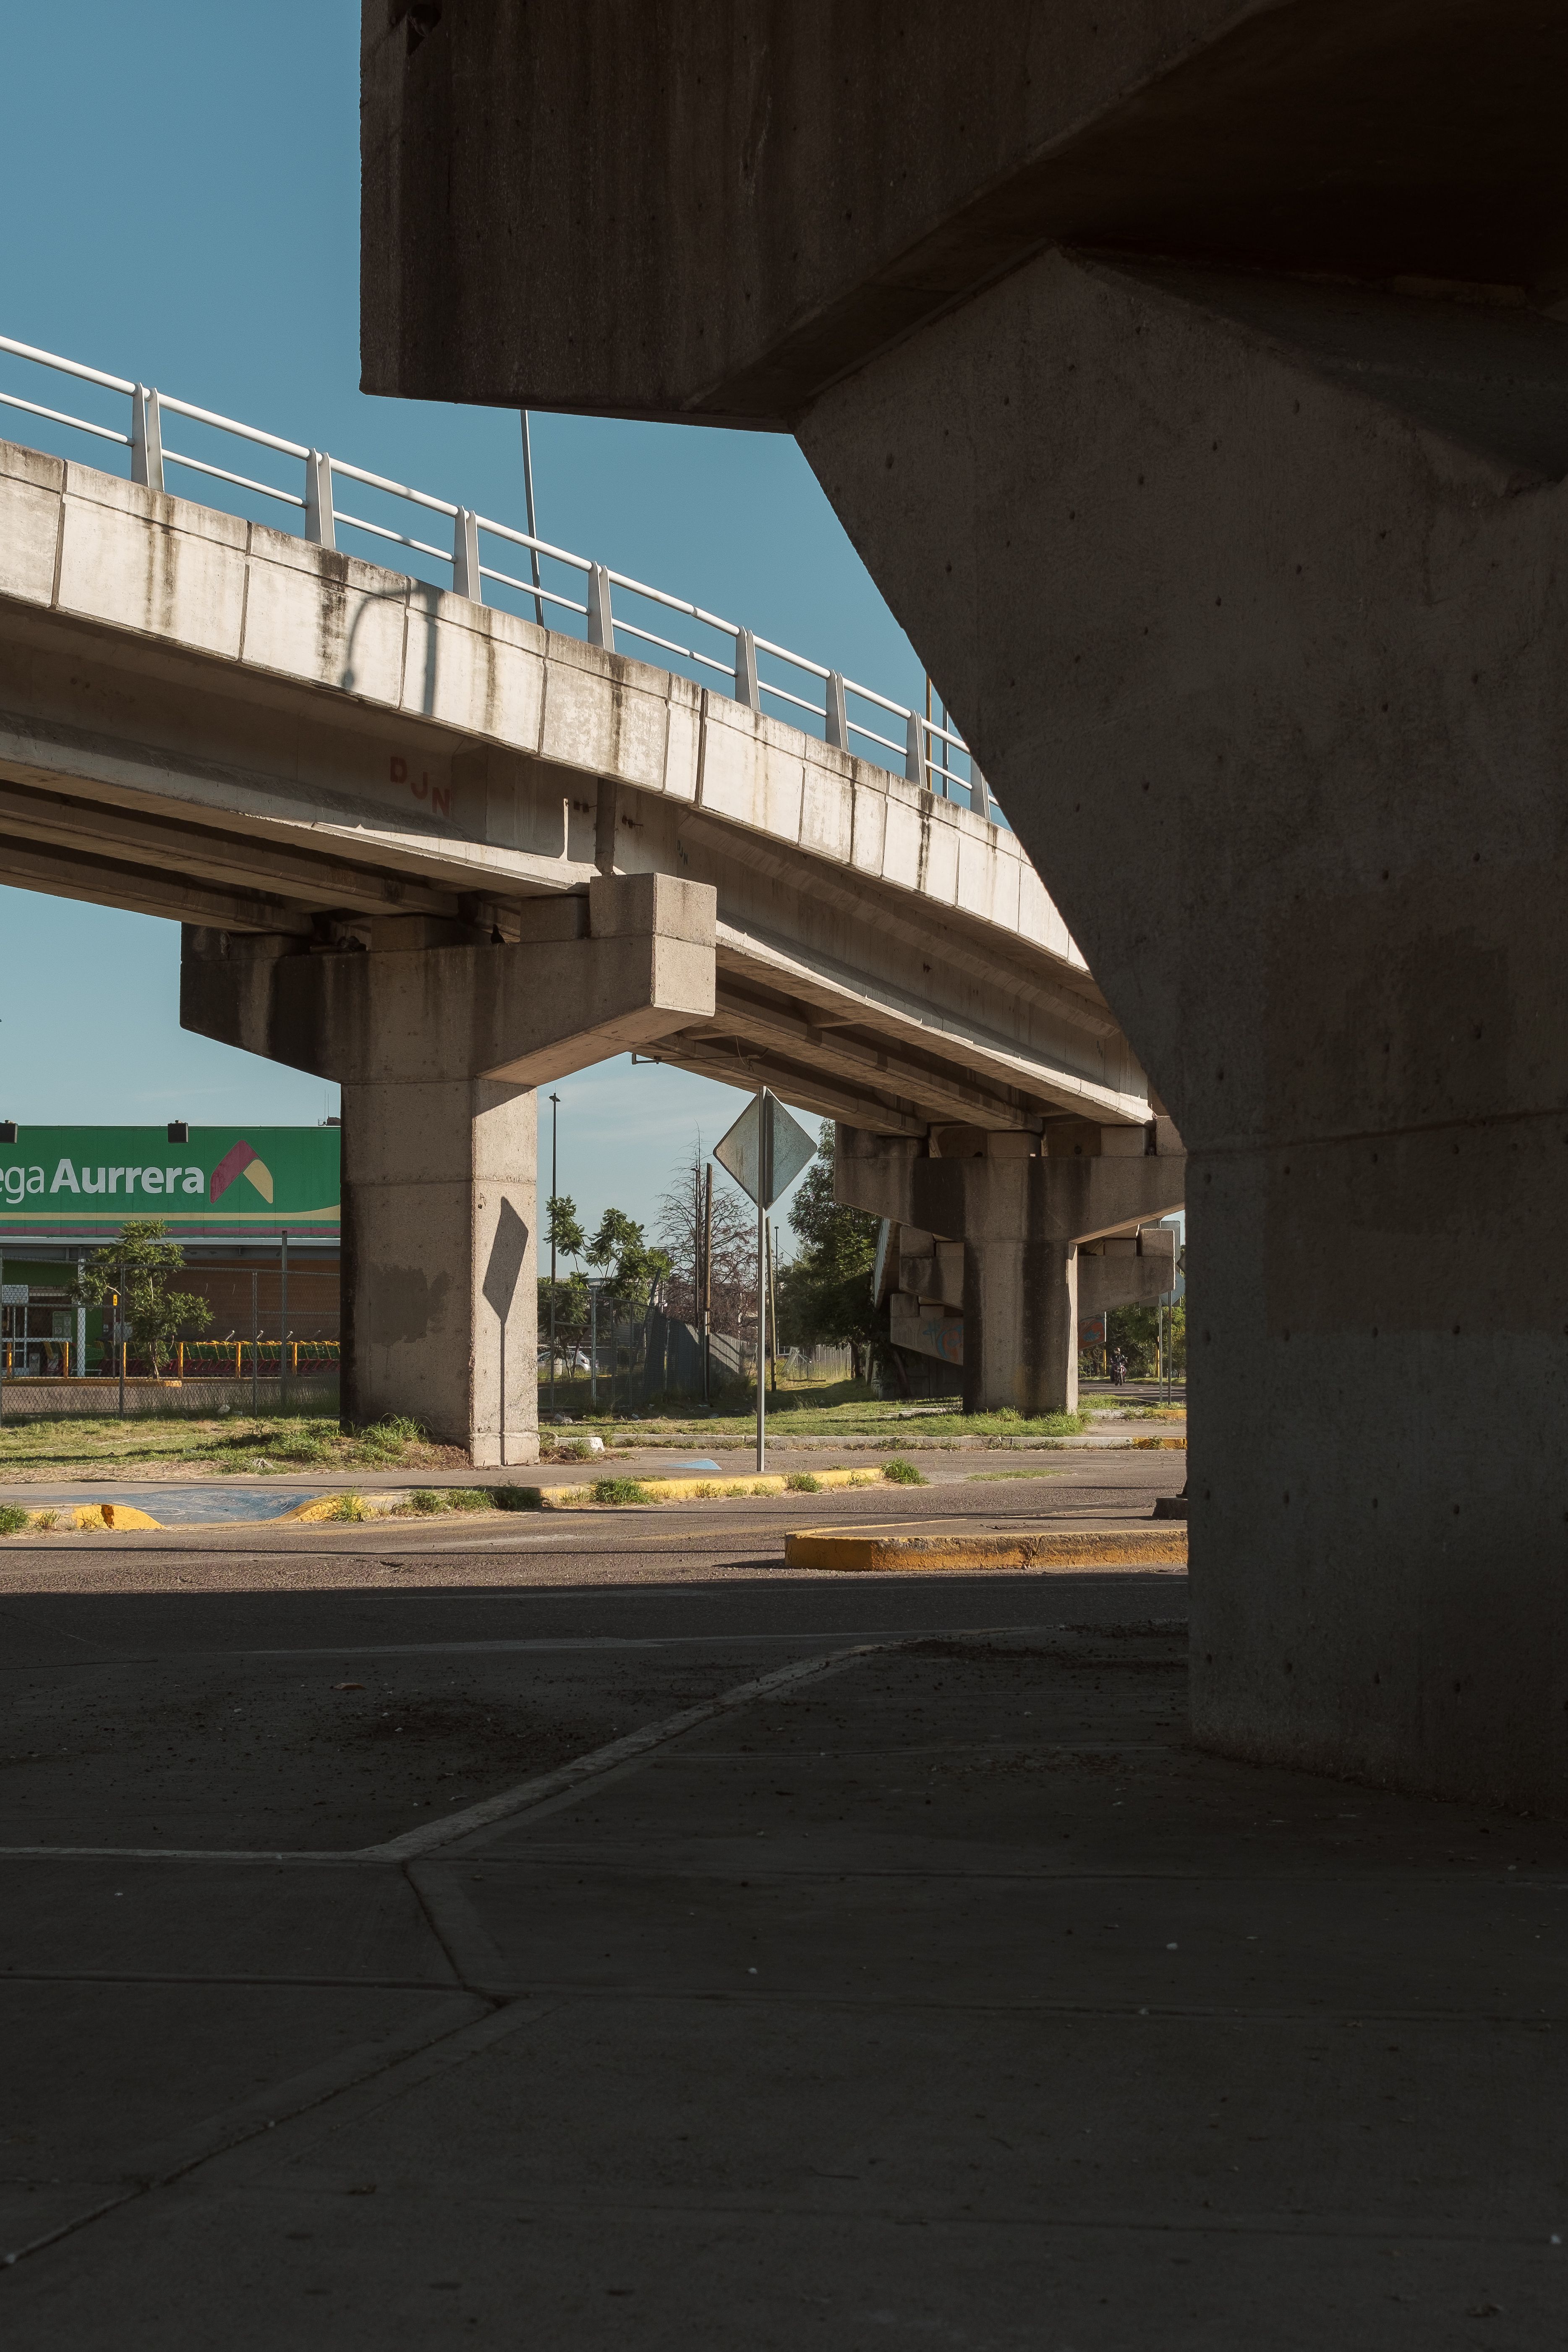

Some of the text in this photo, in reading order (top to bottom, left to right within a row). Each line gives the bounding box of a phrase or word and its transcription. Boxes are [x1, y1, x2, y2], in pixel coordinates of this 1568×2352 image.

[390, 757, 450, 818] DJN
[0, 1159, 204, 1204] ga Aurrera
